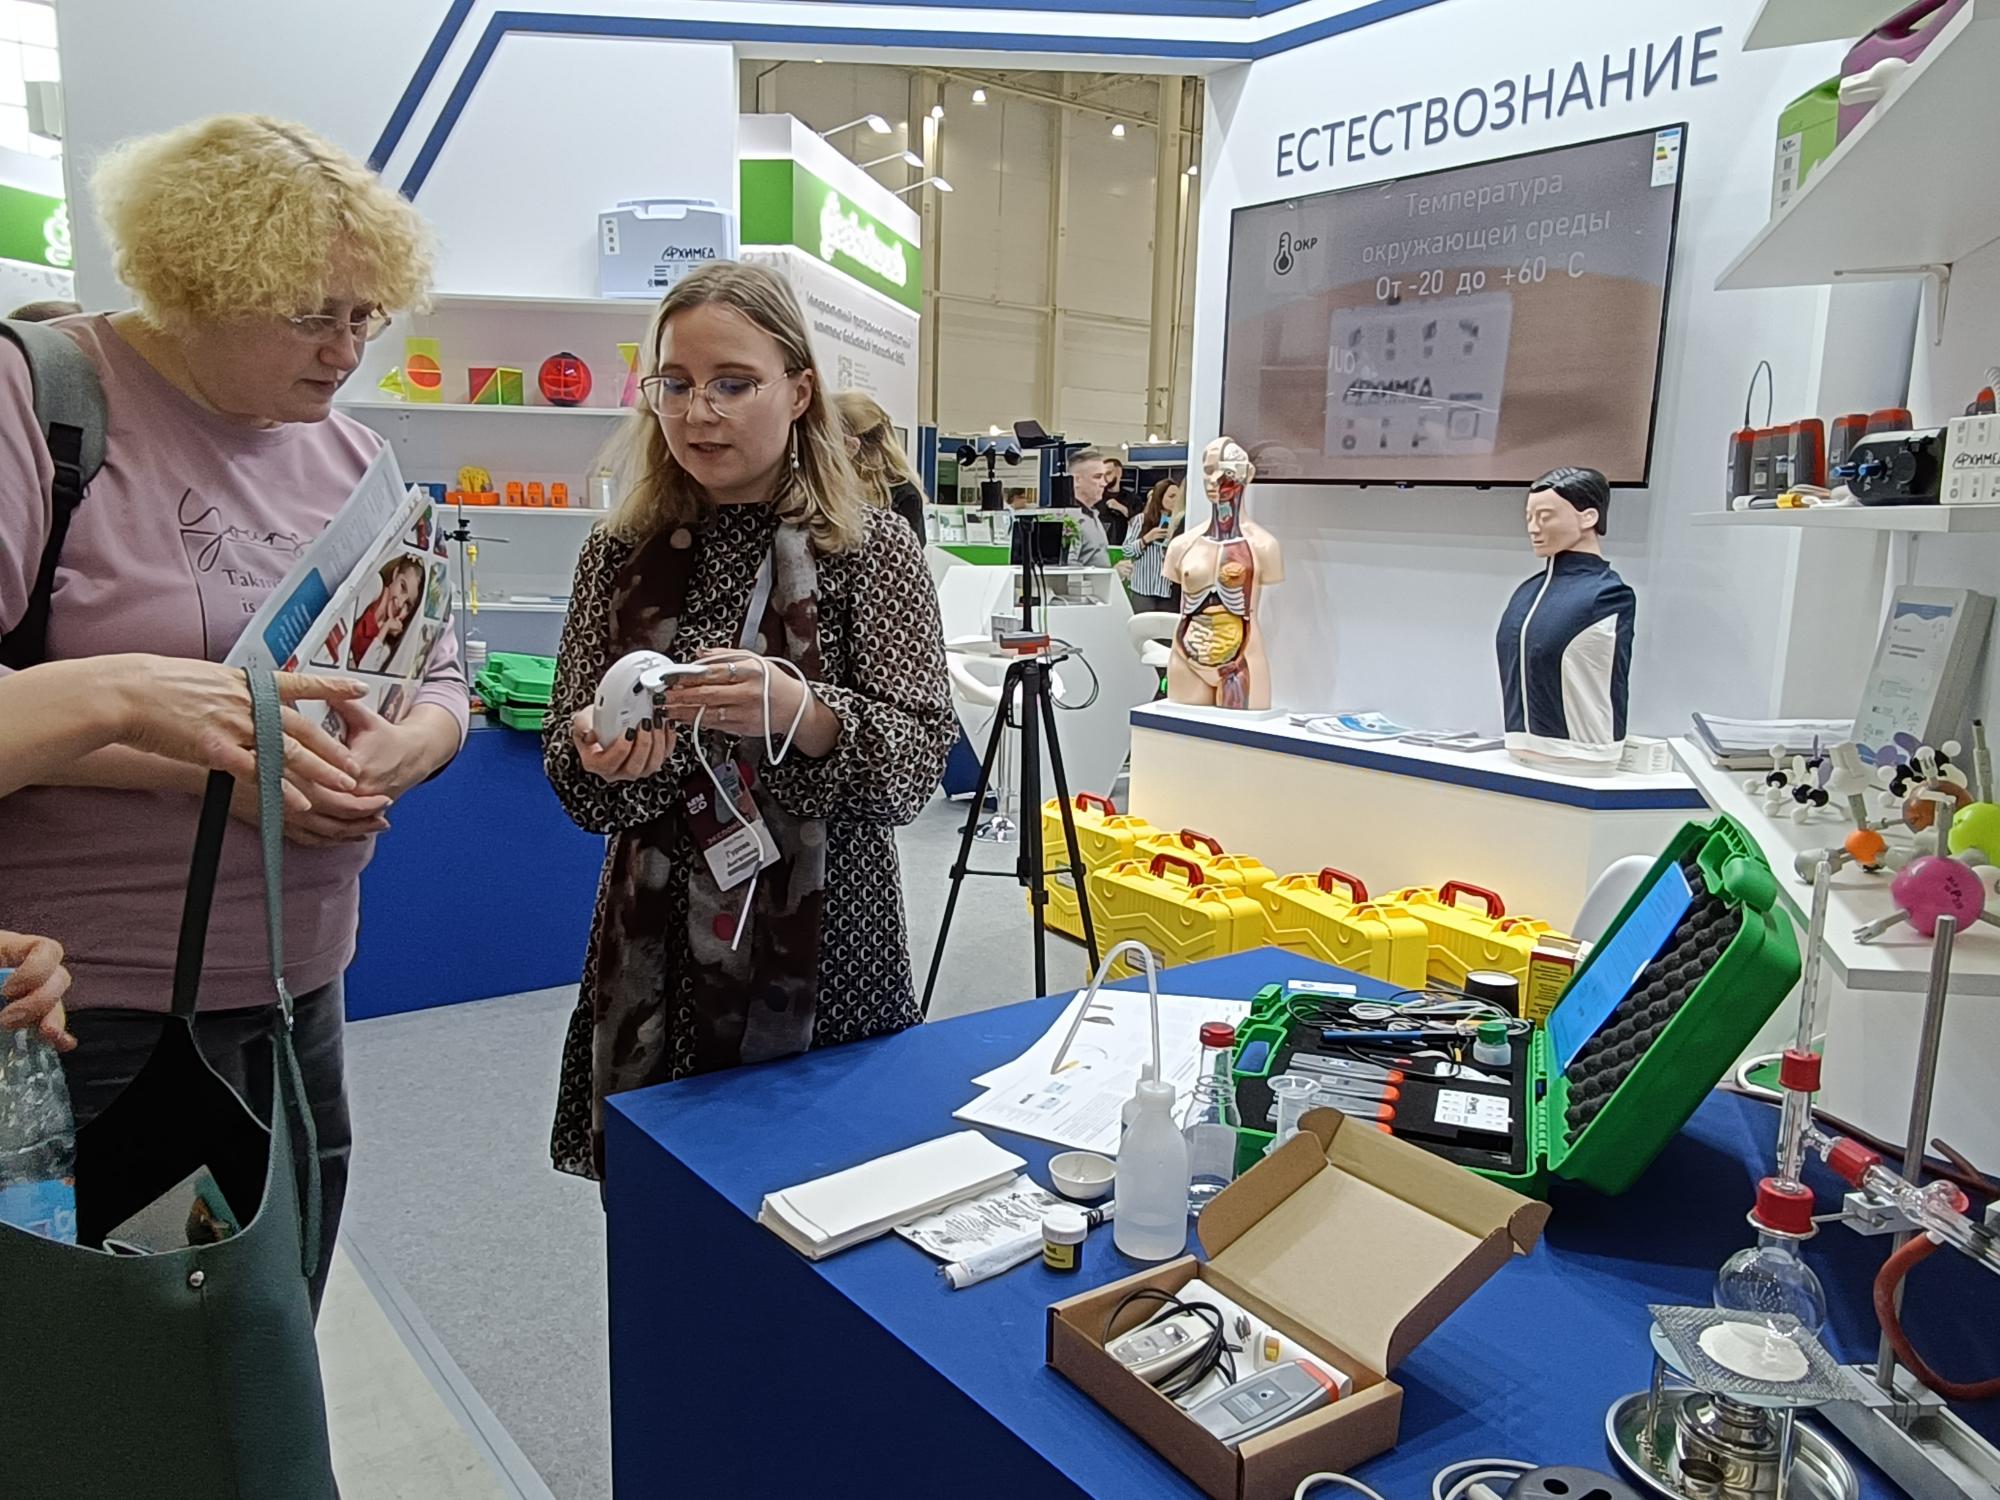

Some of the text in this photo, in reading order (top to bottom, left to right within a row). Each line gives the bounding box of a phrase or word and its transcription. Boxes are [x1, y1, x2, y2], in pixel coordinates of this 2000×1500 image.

[1276, 25, 1723, 178] ЕСТЕСТВОЗНАНИЕ
[1405, 173, 1564, 218] Температура
[1361, 210, 1612, 266] окружающей среды
[1375, 275, 1402, 300] От
[1408, 269, 1444, 296] -20
[1455, 270, 1486, 295] до
[1501, 255, 1547, 287] +60
[1952, 452, 2000, 468] АРХИМЕ
[241, 597, 256, 614] is
